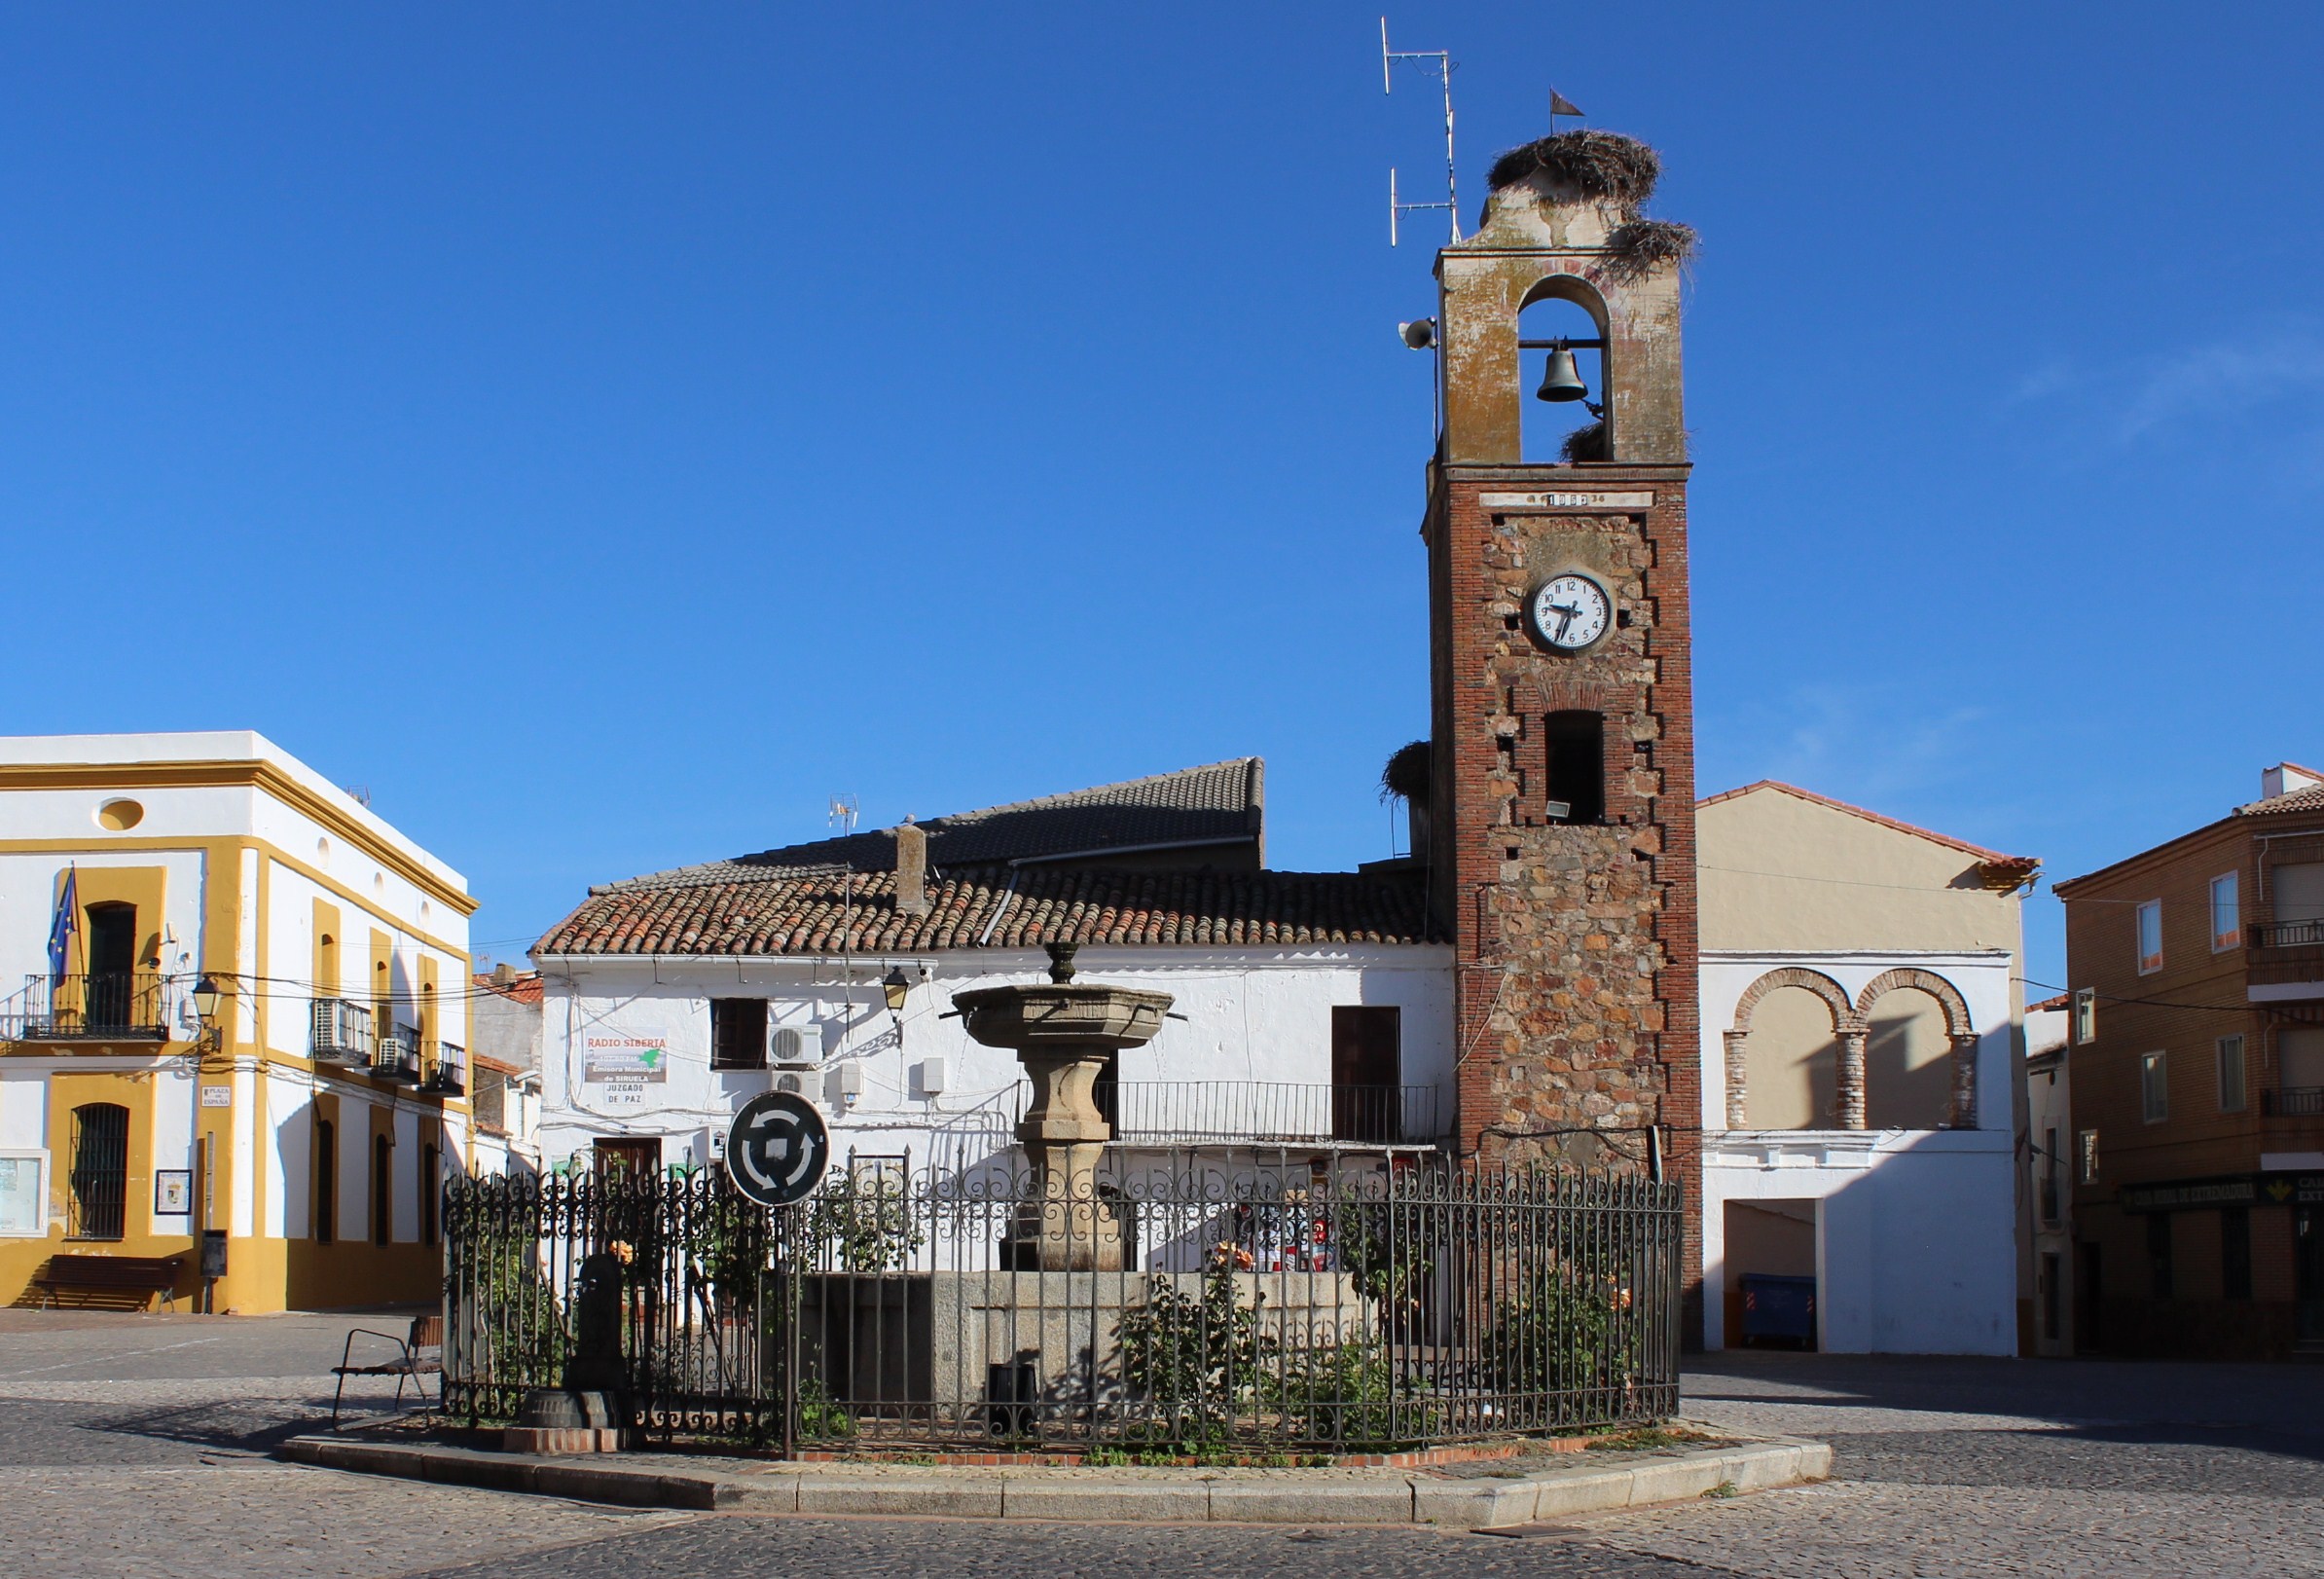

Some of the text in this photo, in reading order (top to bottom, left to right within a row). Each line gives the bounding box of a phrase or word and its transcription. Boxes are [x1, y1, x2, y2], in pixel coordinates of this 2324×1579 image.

[1555, 584, 1561, 594] 11
[1567, 581, 1576, 591] 12
[1544, 594, 1553, 604] 10
[1592, 594, 1598, 604] 2
[1542, 607, 1547, 616] 9
[1596, 606, 1602, 616] 3
[1544, 620, 1551, 630] 8
[1592, 620, 1598, 630] 4
[1569, 633, 1576, 643] 6
[1582, 629, 1589, 639] 5
[588, 1038, 667, 1048] RADIO SIBERIA
